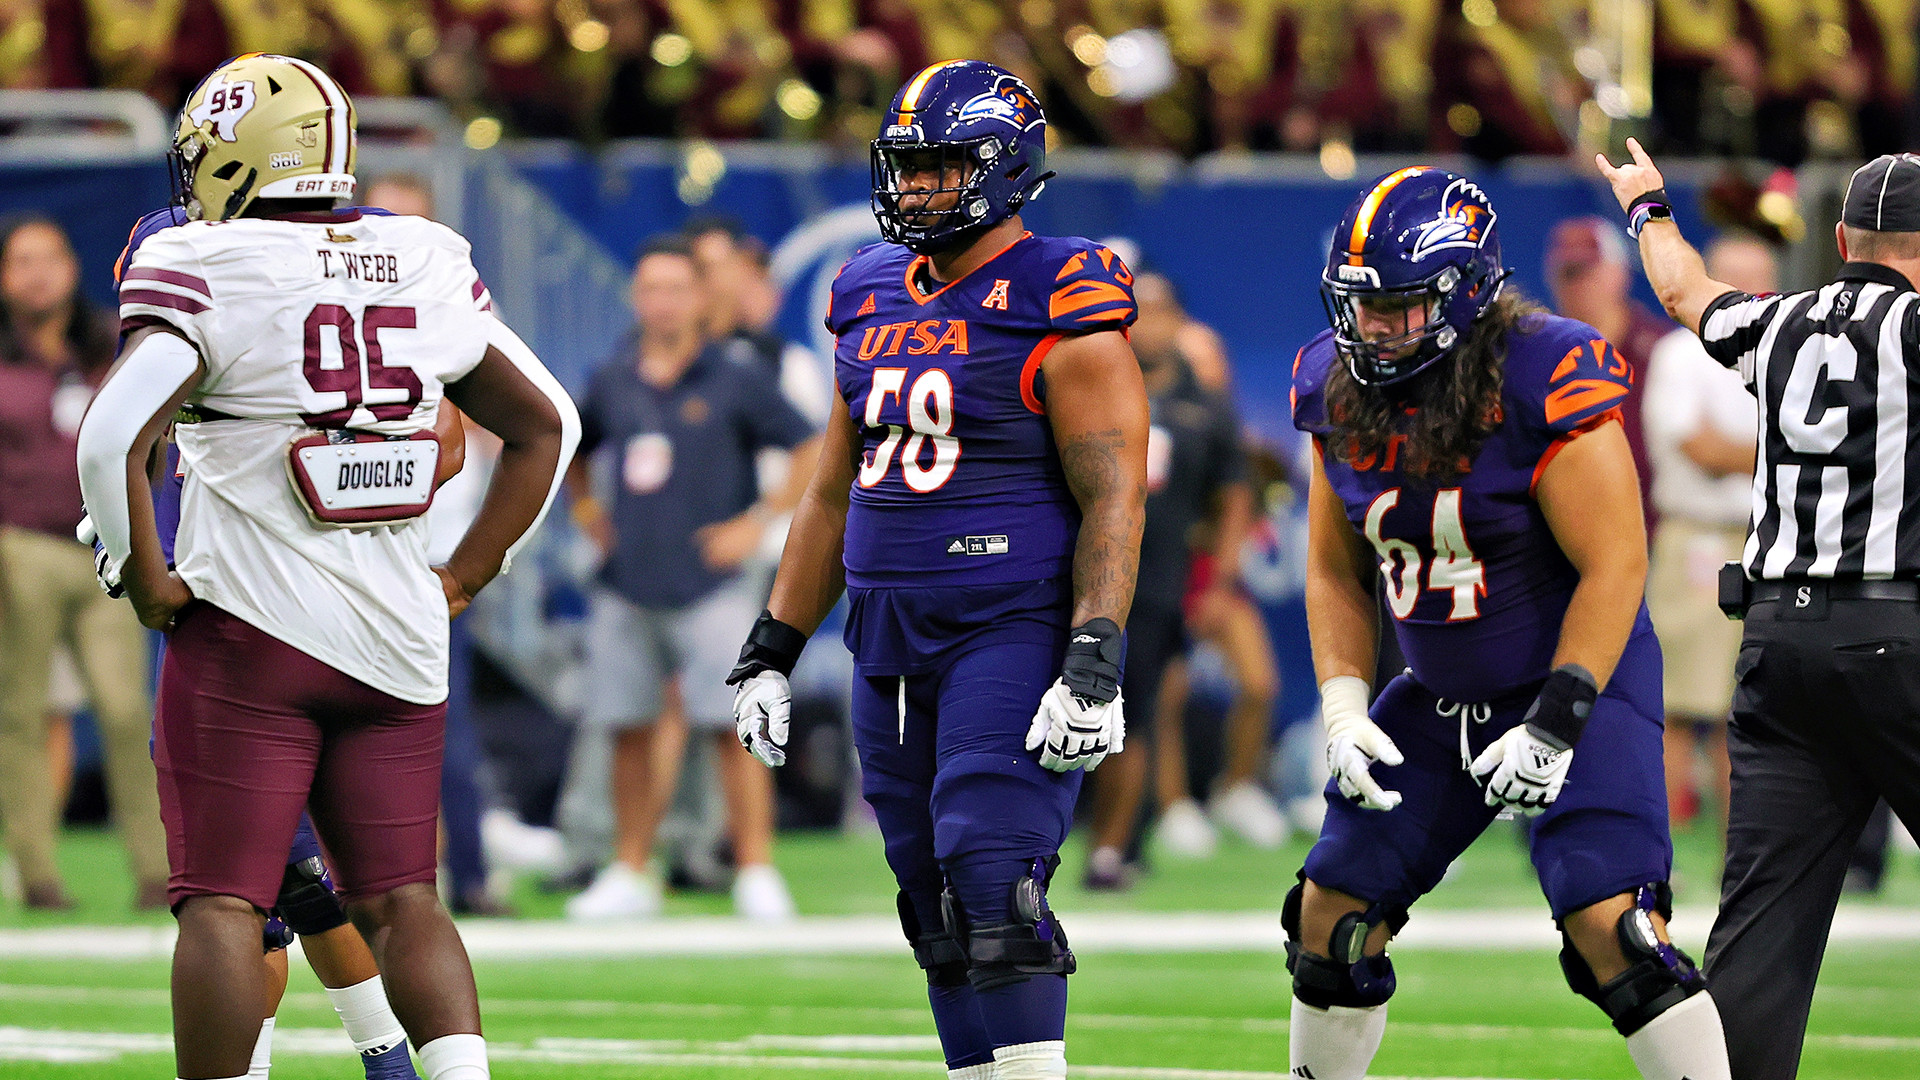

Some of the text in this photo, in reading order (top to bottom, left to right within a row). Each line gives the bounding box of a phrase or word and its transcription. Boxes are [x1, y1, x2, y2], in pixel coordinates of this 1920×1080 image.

[210, 85, 245, 115] 95
[886, 126, 913, 137] UTSA
[295, 180, 325, 192] EAT
[316, 249, 399, 283] T. WEBB
[856, 319, 970, 361] UTSA
[298, 303, 424, 430] 95
[1779, 332, 1858, 455] C
[858, 366, 963, 493] 58
[337, 460, 416, 491] DOUGLAS
[1363, 486, 1488, 622] 64
[1795, 585, 1811, 608] S
